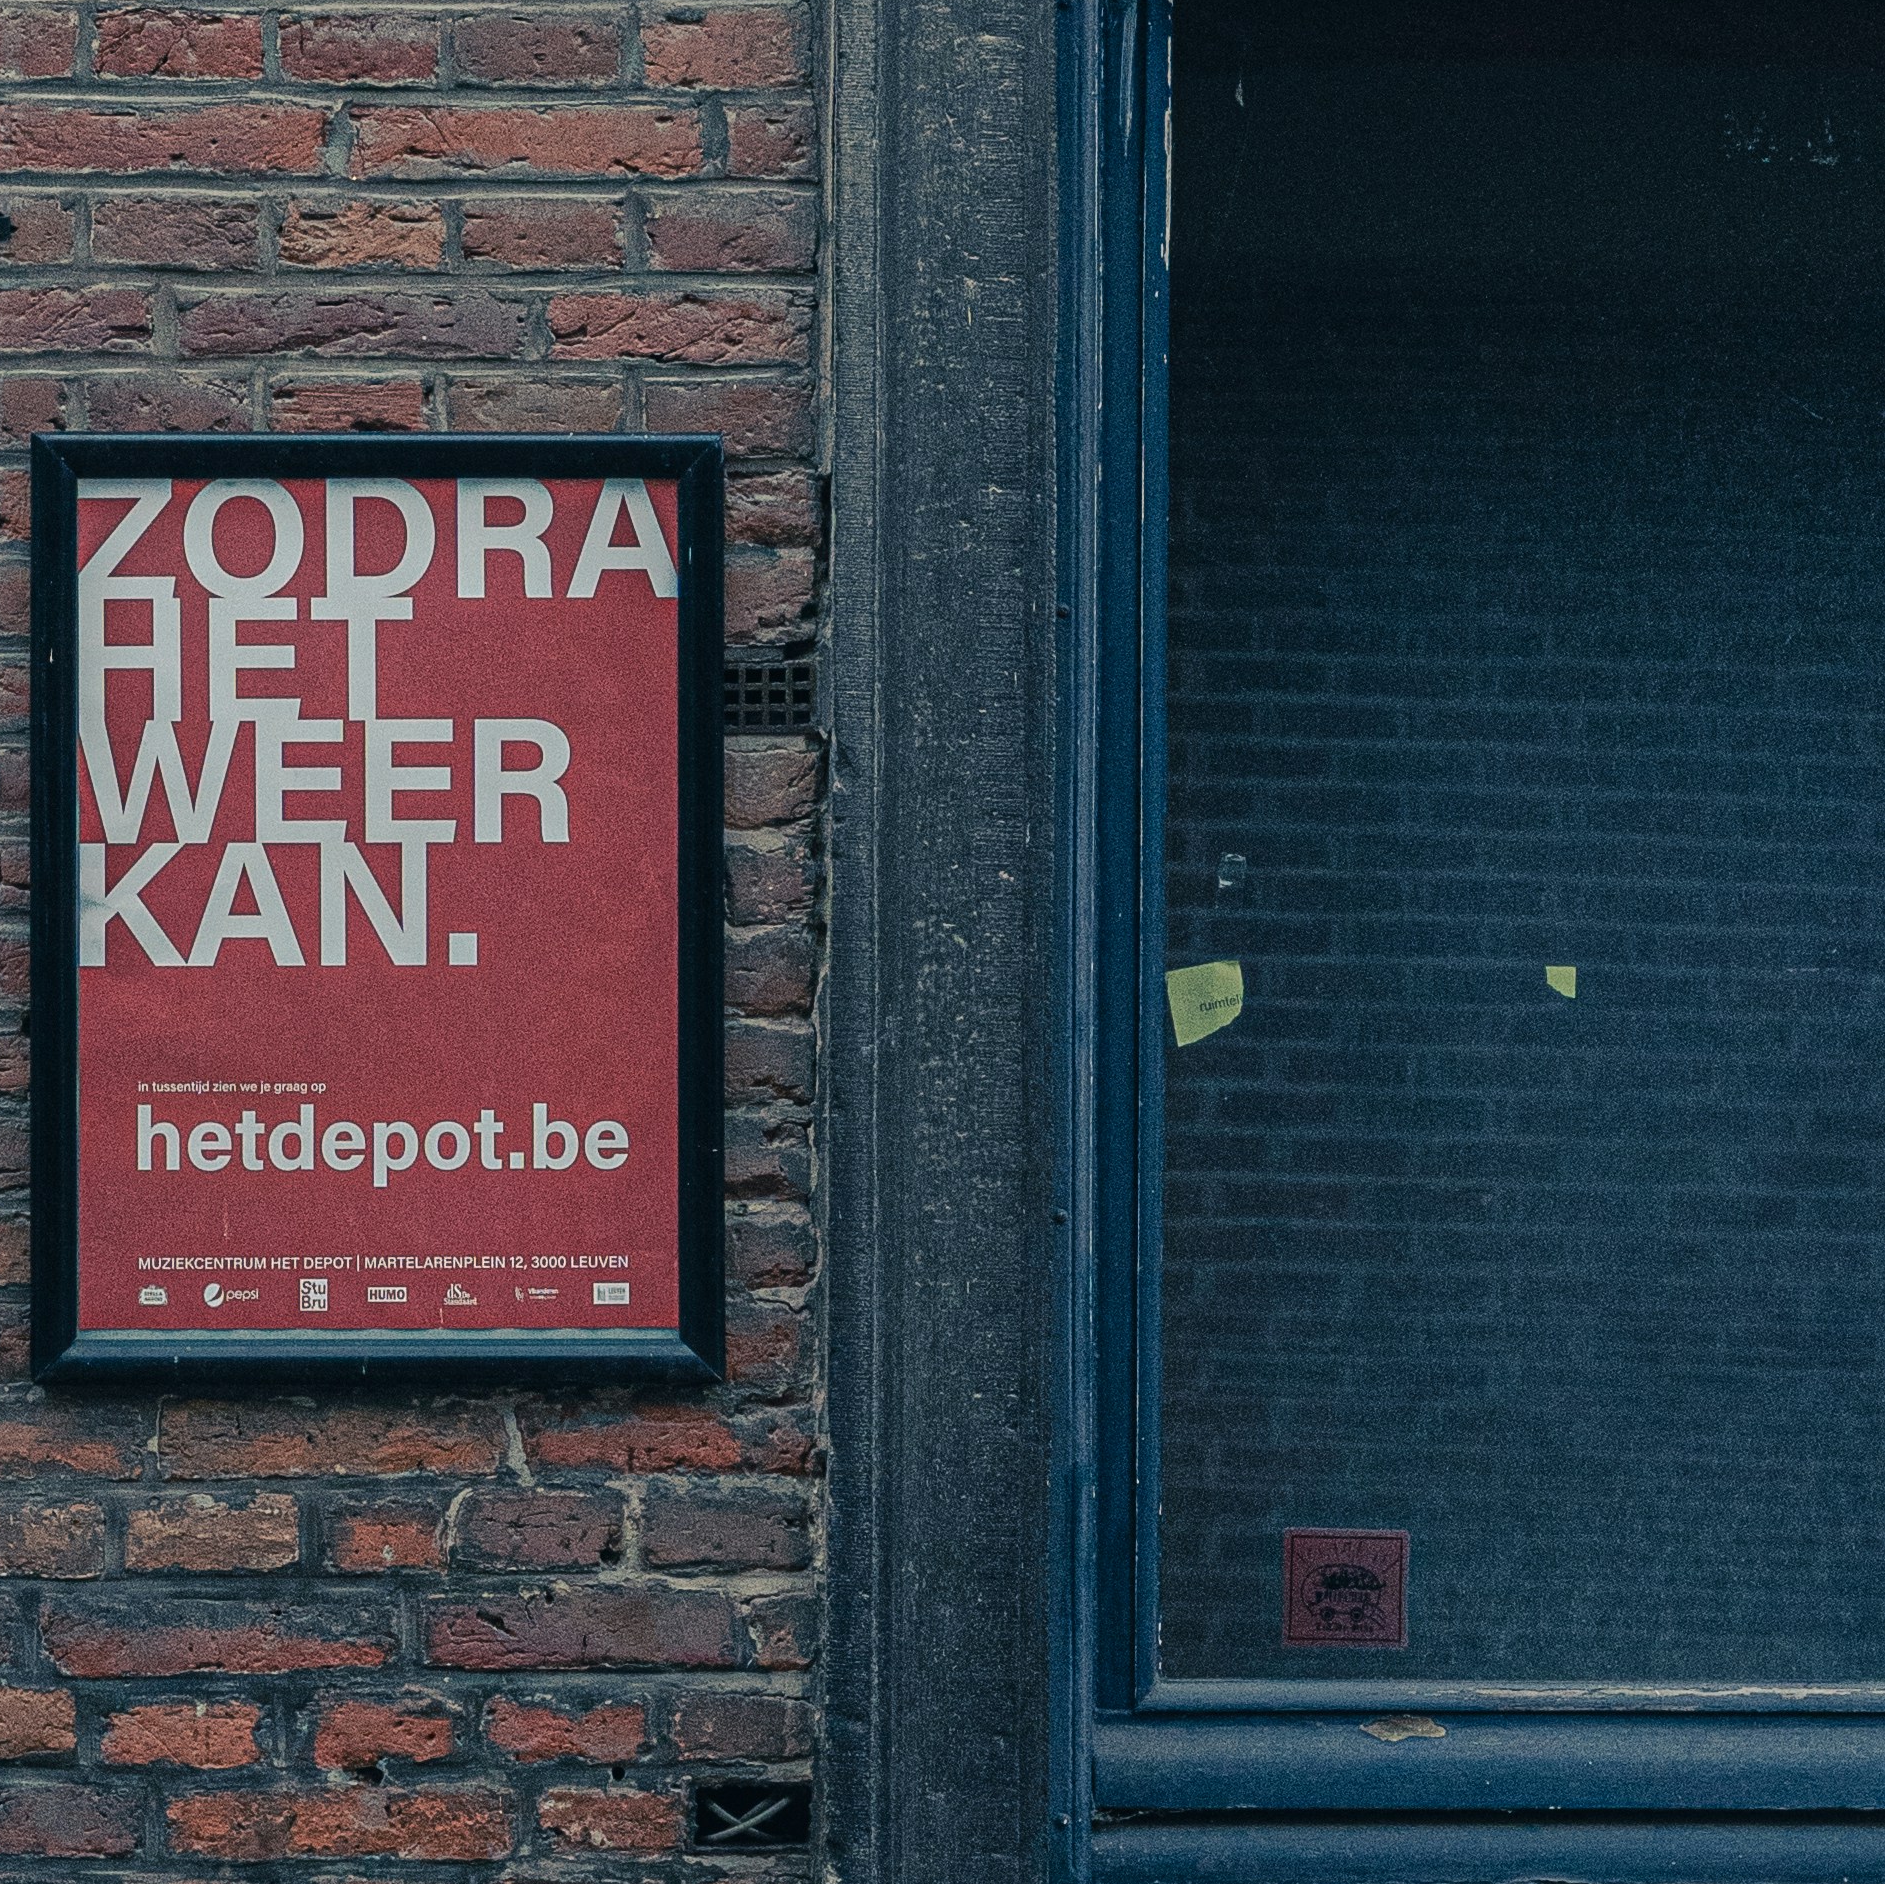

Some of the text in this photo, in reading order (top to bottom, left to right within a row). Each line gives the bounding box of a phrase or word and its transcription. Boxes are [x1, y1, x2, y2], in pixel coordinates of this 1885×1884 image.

[78, 478, 678, 599] ZODRA
[78, 597, 413, 722] HET
[78, 718, 571, 844] WEER
[79, 842, 478, 967] KAN.
[137, 1081, 327, 1095] in tussentijd zien we je graag op
[136, 1102, 629, 1188] hetdepot.be
[138, 1255, 629, 1271] MUZIEKCENTRUM HET DEPOT MARTELARENPLEIN 12, 3000 LEUVEN
[226, 1287, 259, 1302] pepsi
[301, 1281, 326, 1295] Stu
[369, 1289, 405, 1300] HUMO
[301, 1296, 326, 1309] Bru
